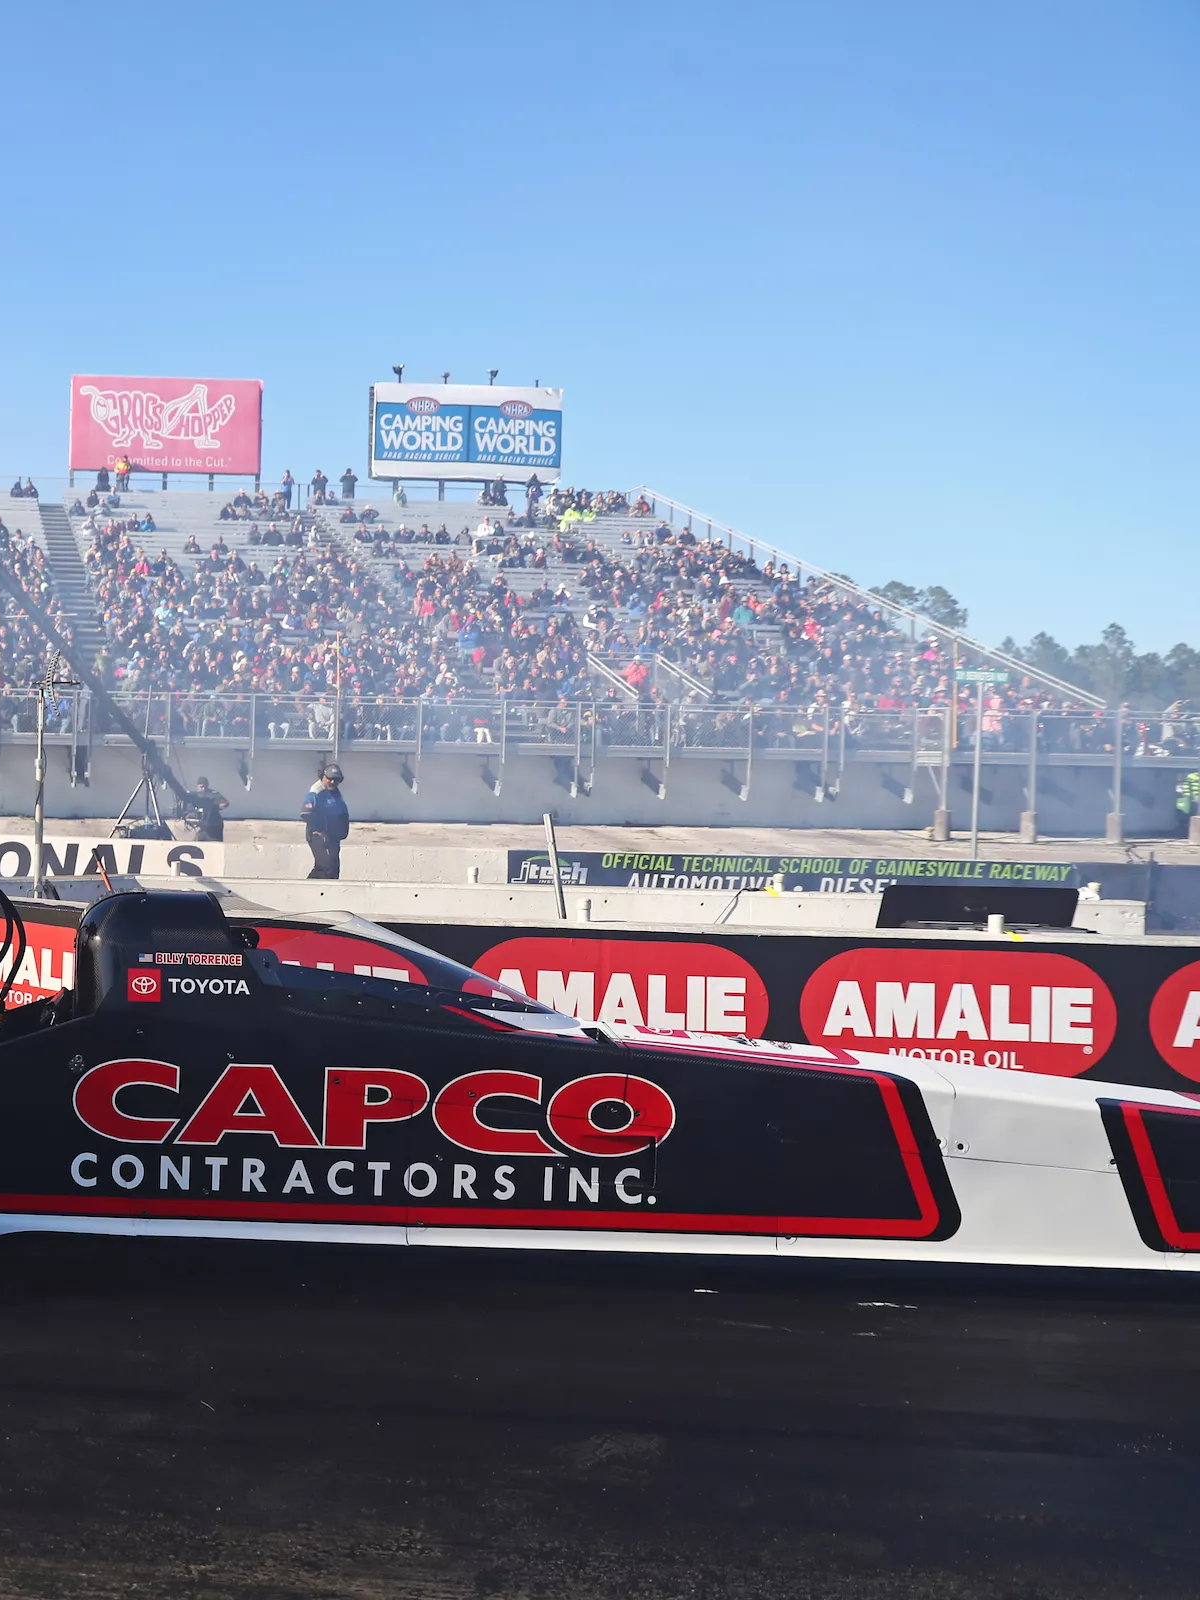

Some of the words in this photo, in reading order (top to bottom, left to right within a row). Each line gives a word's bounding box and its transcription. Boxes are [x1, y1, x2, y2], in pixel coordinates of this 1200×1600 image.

[409, 400, 436, 412] NHRA
[504, 404, 530, 416] NHRA
[380, 414, 463, 432] CAMPING
[474, 417, 556, 437] CAMPING
[380, 430, 463, 451] WORLD
[474, 433, 556, 456] WORLD
[107, 455, 168, 467] Comitted
[171, 456, 182, 467] to
[183, 456, 202, 467] the
[602, 853, 675, 871] OFFICIAL
[682, 856, 772, 873] TECHNICAL
[778, 858, 842, 874] SCHOOL
[851, 859, 870, 875] OF
[875, 860, 983, 879] GAINESVILLE
[989, 863, 1072, 881] RACEWAY
[819, 877, 899, 894] DIESE
[155, 952, 185, 965] BILLY
[186, 953, 243, 966] TORRENCE
[168, 978, 250, 995] TOYOTA
[822, 980, 1094, 1044] AMALIE
[983, 1049, 1025, 1071] OIL
[72, 1058, 676, 1158] CAPCO
[71, 1152, 516, 1200] CONTRACTORS
[543, 1165, 658, 1205] INC.
